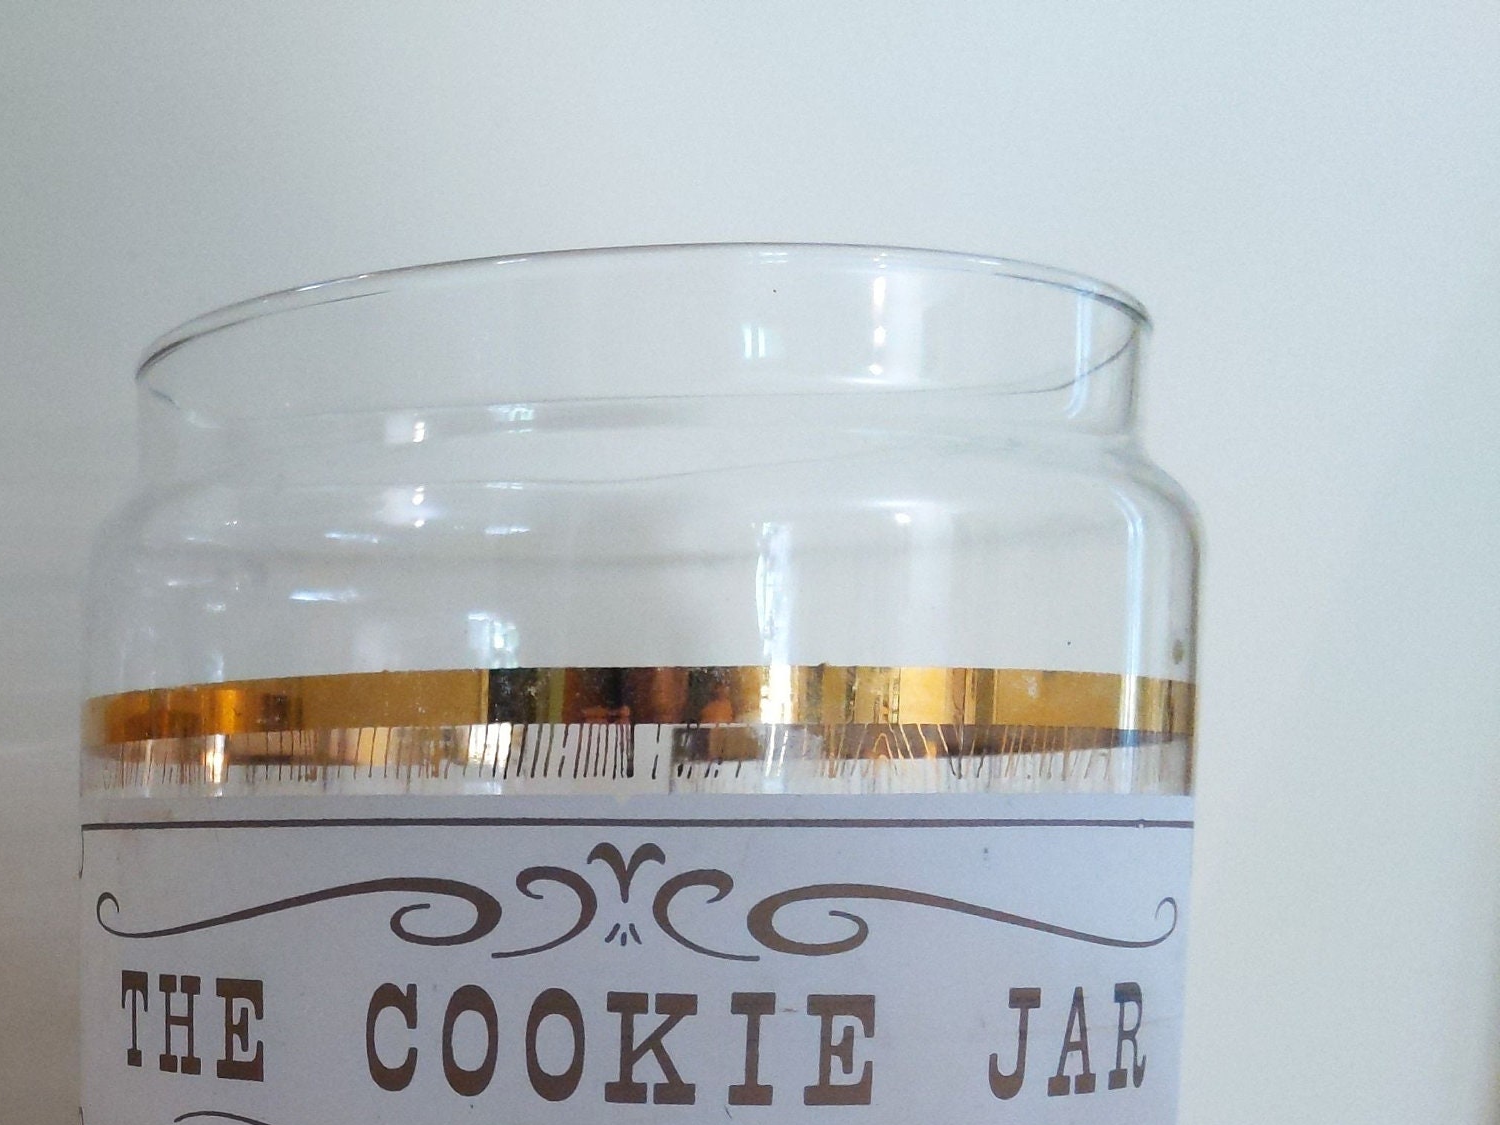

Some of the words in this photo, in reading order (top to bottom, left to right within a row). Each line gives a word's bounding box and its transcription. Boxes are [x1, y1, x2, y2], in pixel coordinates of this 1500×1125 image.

[121, 969, 266, 1083] THE
[365, 984, 876, 1107] COOKIE
[987, 981, 1148, 1102] JAR
